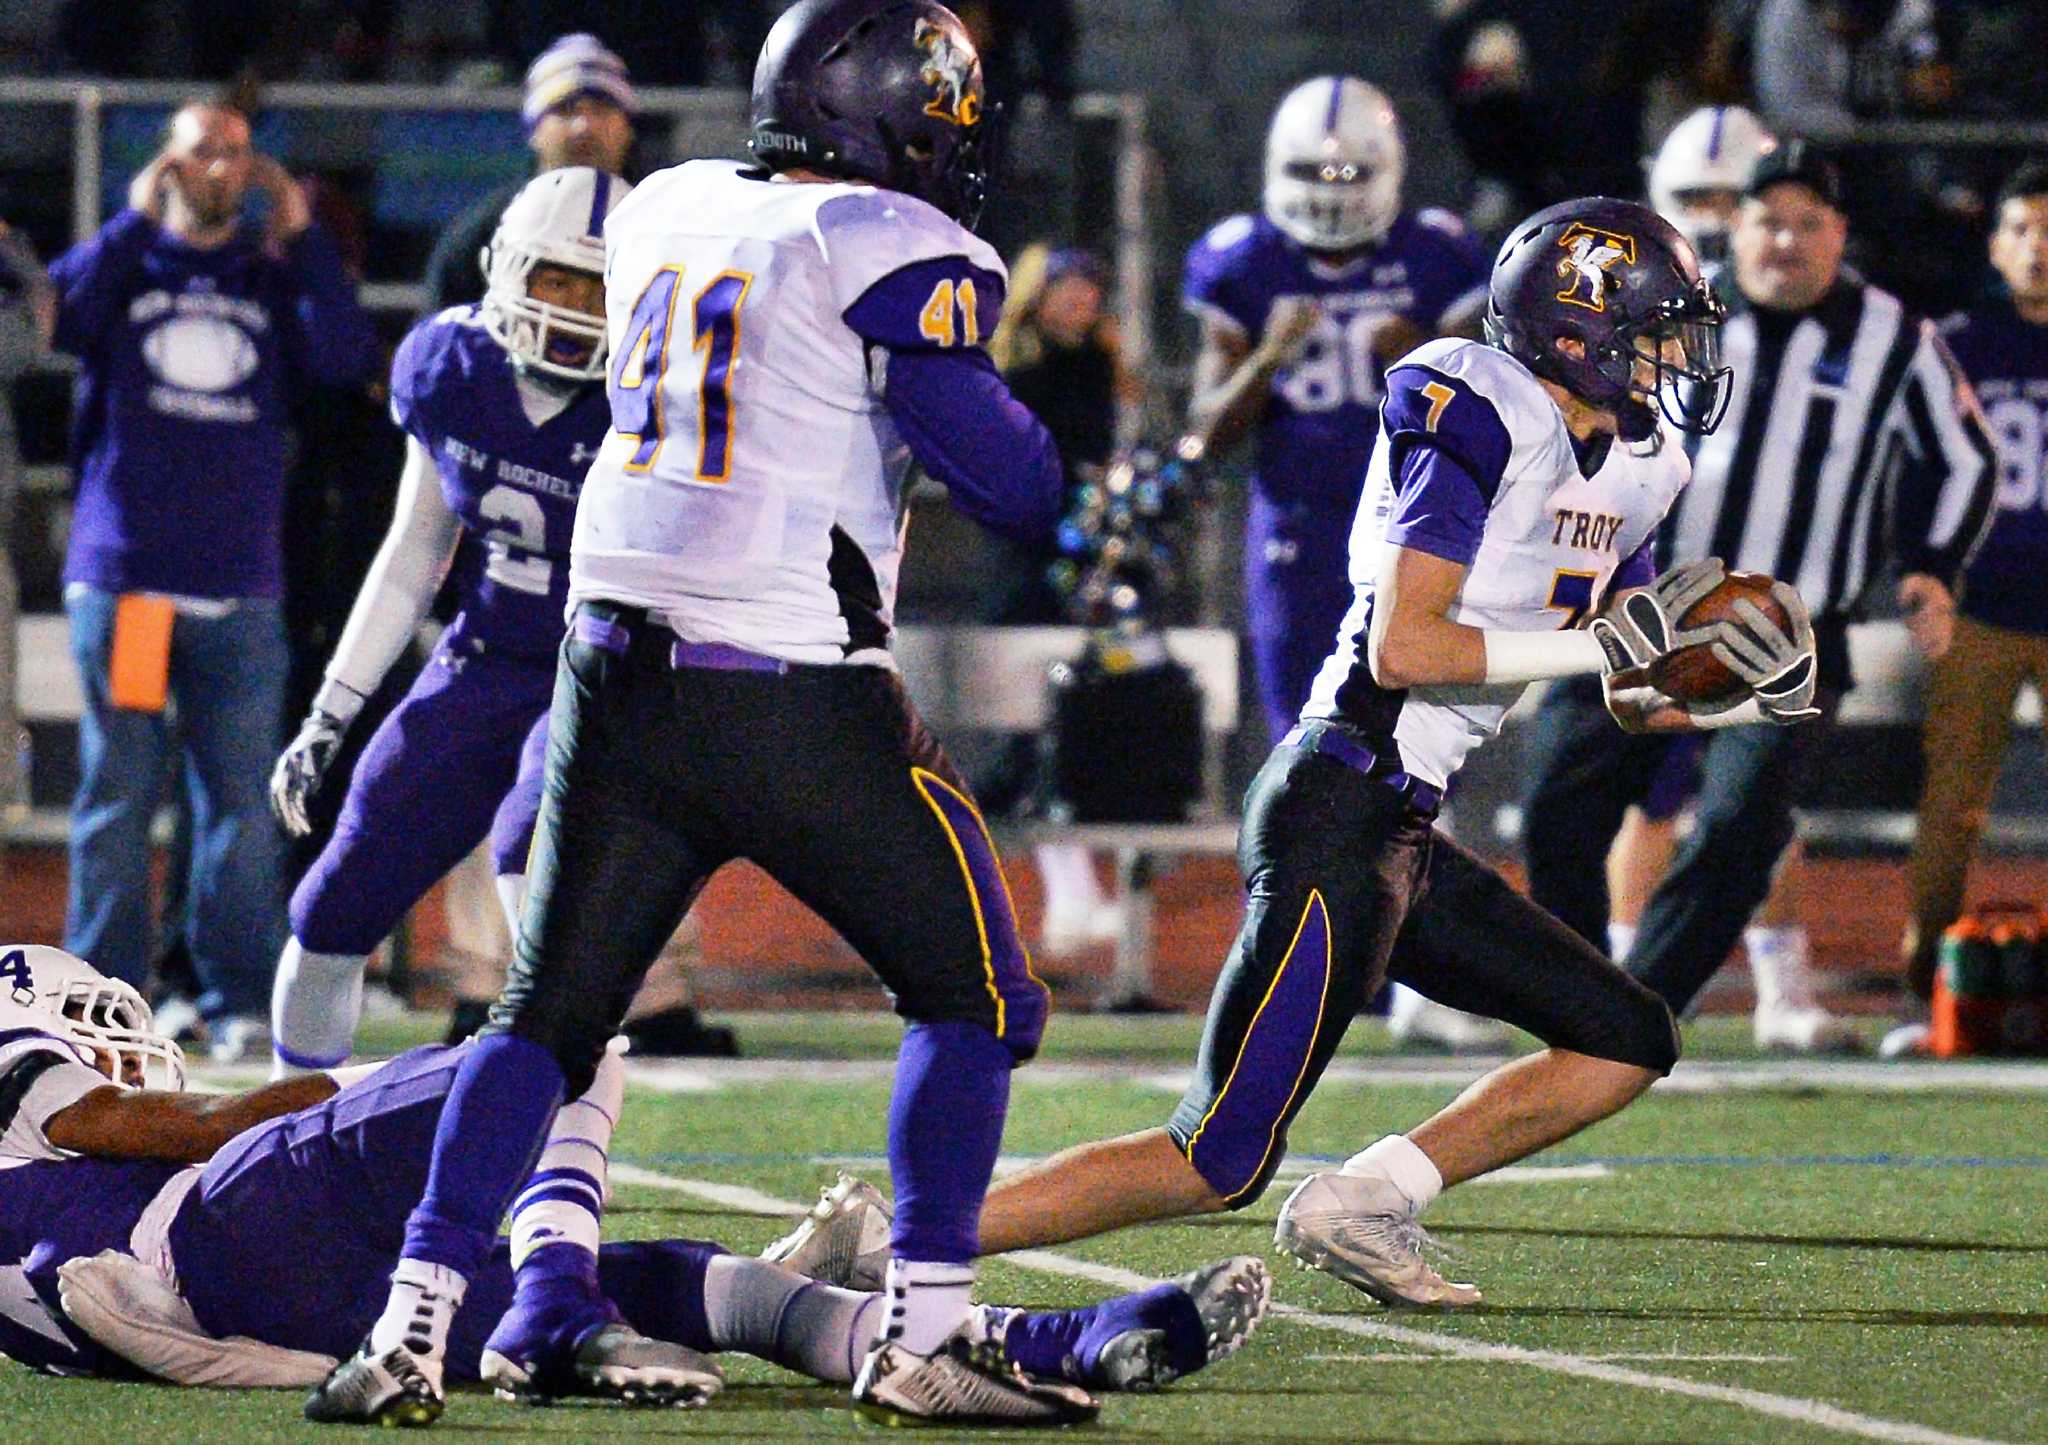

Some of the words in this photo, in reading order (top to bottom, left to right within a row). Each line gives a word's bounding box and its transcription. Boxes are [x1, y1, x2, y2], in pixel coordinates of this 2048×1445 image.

[918, 278, 978, 347] 41
[610, 263, 754, 483] 41
[1421, 380, 1456, 433] 7
[444, 434, 488, 472] NEW
[1987, 400, 2048, 511] 8
[479, 484, 552, 596] 2
[1551, 508, 1624, 552] TROY
[1545, 567, 1599, 632] 7
[0, 949, 34, 988] 4
